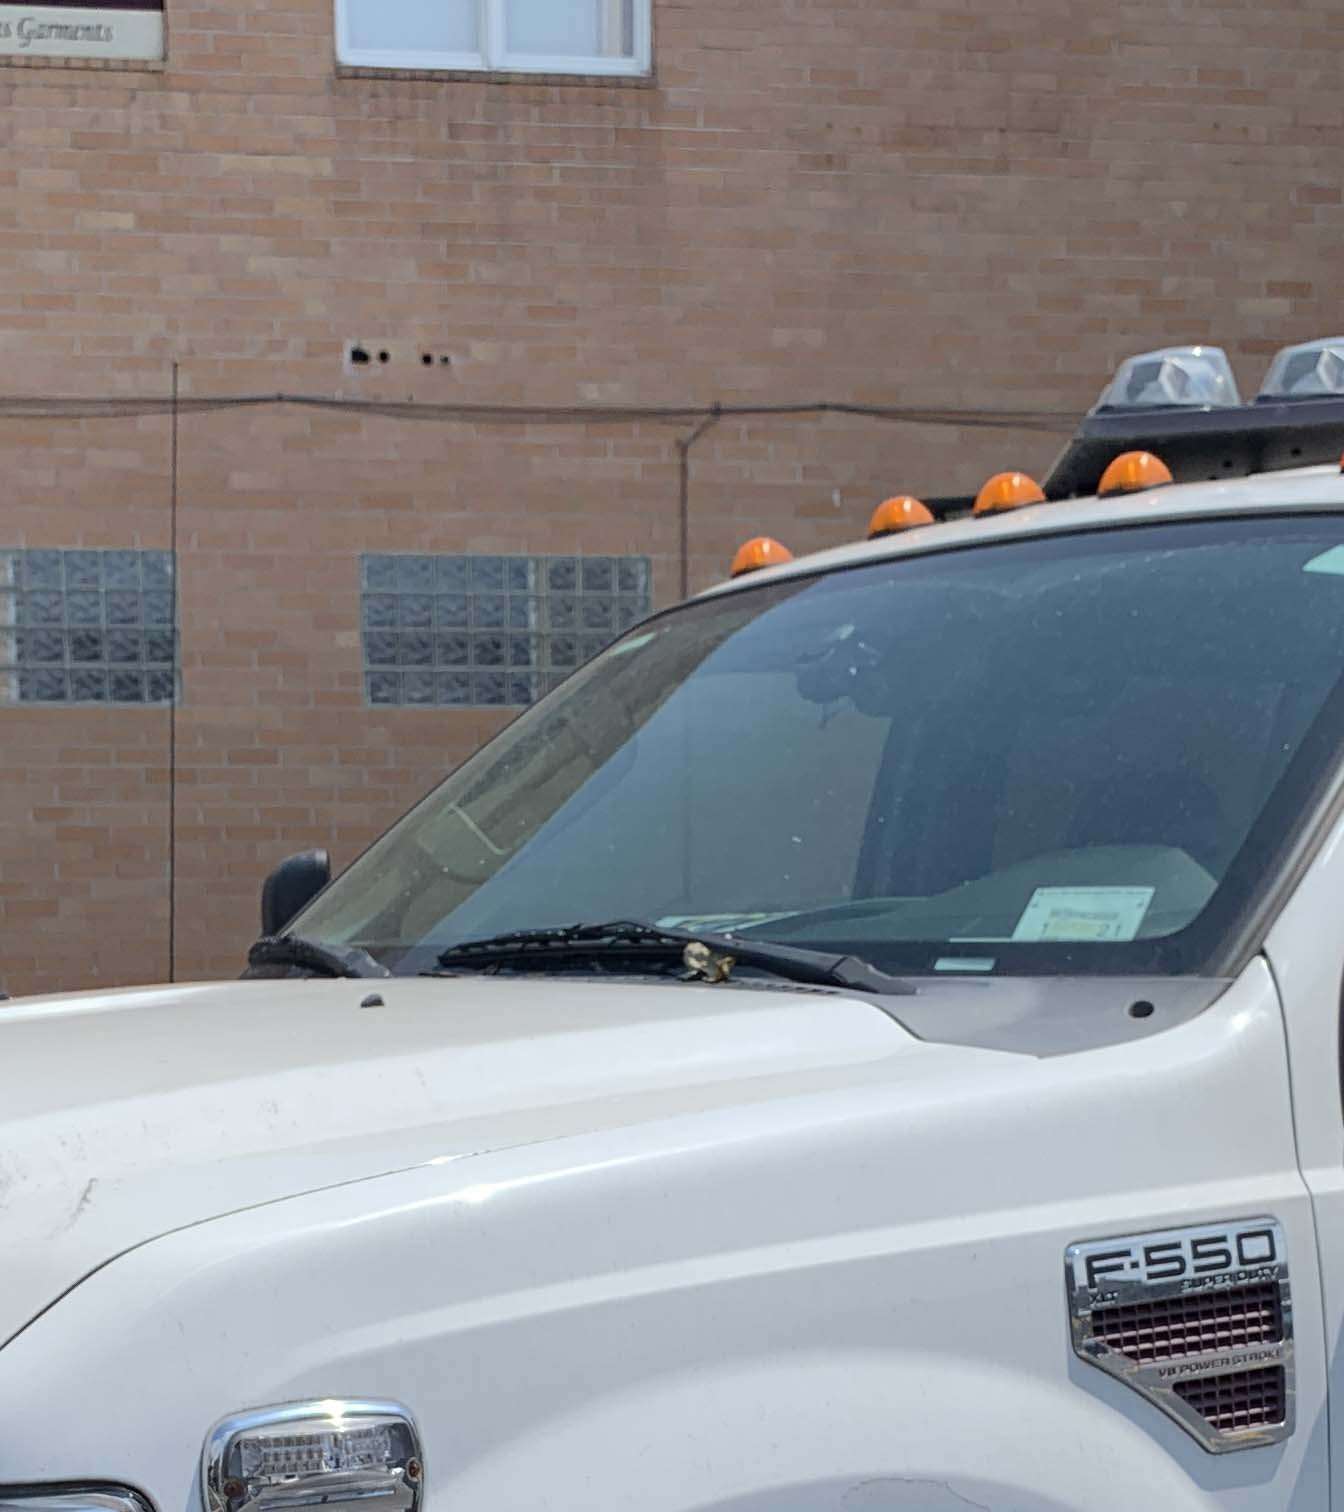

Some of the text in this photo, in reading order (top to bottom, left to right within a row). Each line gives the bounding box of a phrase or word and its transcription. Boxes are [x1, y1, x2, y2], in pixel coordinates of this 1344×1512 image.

[17, 17, 113, 47] Garments
[1085, 1229, 1277, 1289] F-550
[1181, 1265, 1280, 1290] SUPER DUTY
[1179, 1356, 1230, 1373] POWER
[1232, 1348, 1282, 1366] STROKE
